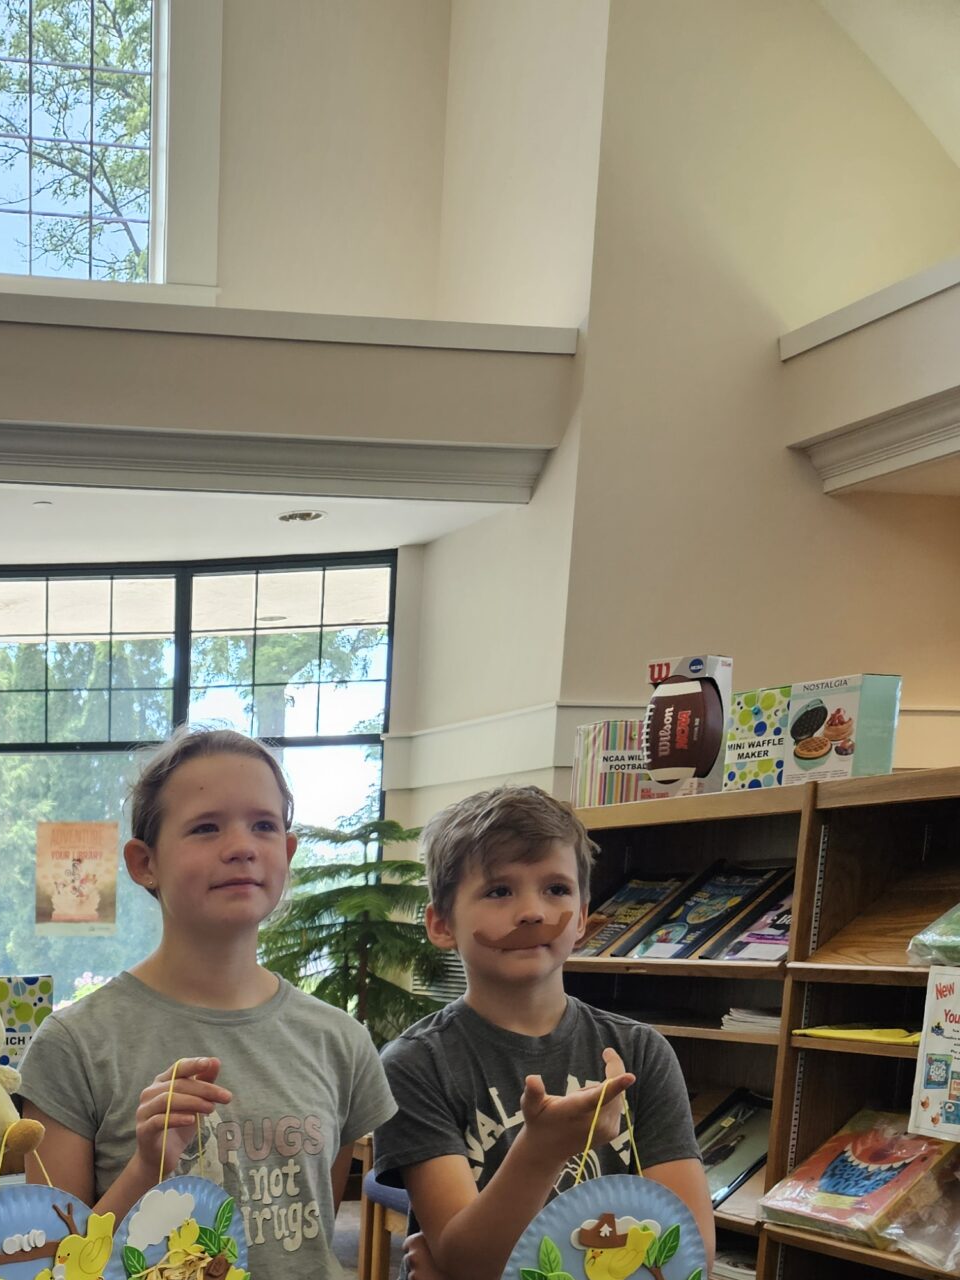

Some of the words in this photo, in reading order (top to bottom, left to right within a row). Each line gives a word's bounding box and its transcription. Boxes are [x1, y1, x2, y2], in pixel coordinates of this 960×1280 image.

[803, 679, 849, 692] NOSTALGIA
[658, 706, 675, 757] Wilson
[727, 742, 745, 751] MINI
[748, 737, 785, 749] WAFFLE
[602, 754, 626, 763] NCAA
[737, 750, 769, 761] MAKER
[609, 763, 647, 771] FOOTBAL
[935, 982, 955, 1000] New
[6, 1036, 25, 1046] ICH
[216, 1114, 326, 1164] PUGS
[248, 1159, 301, 1204] not
